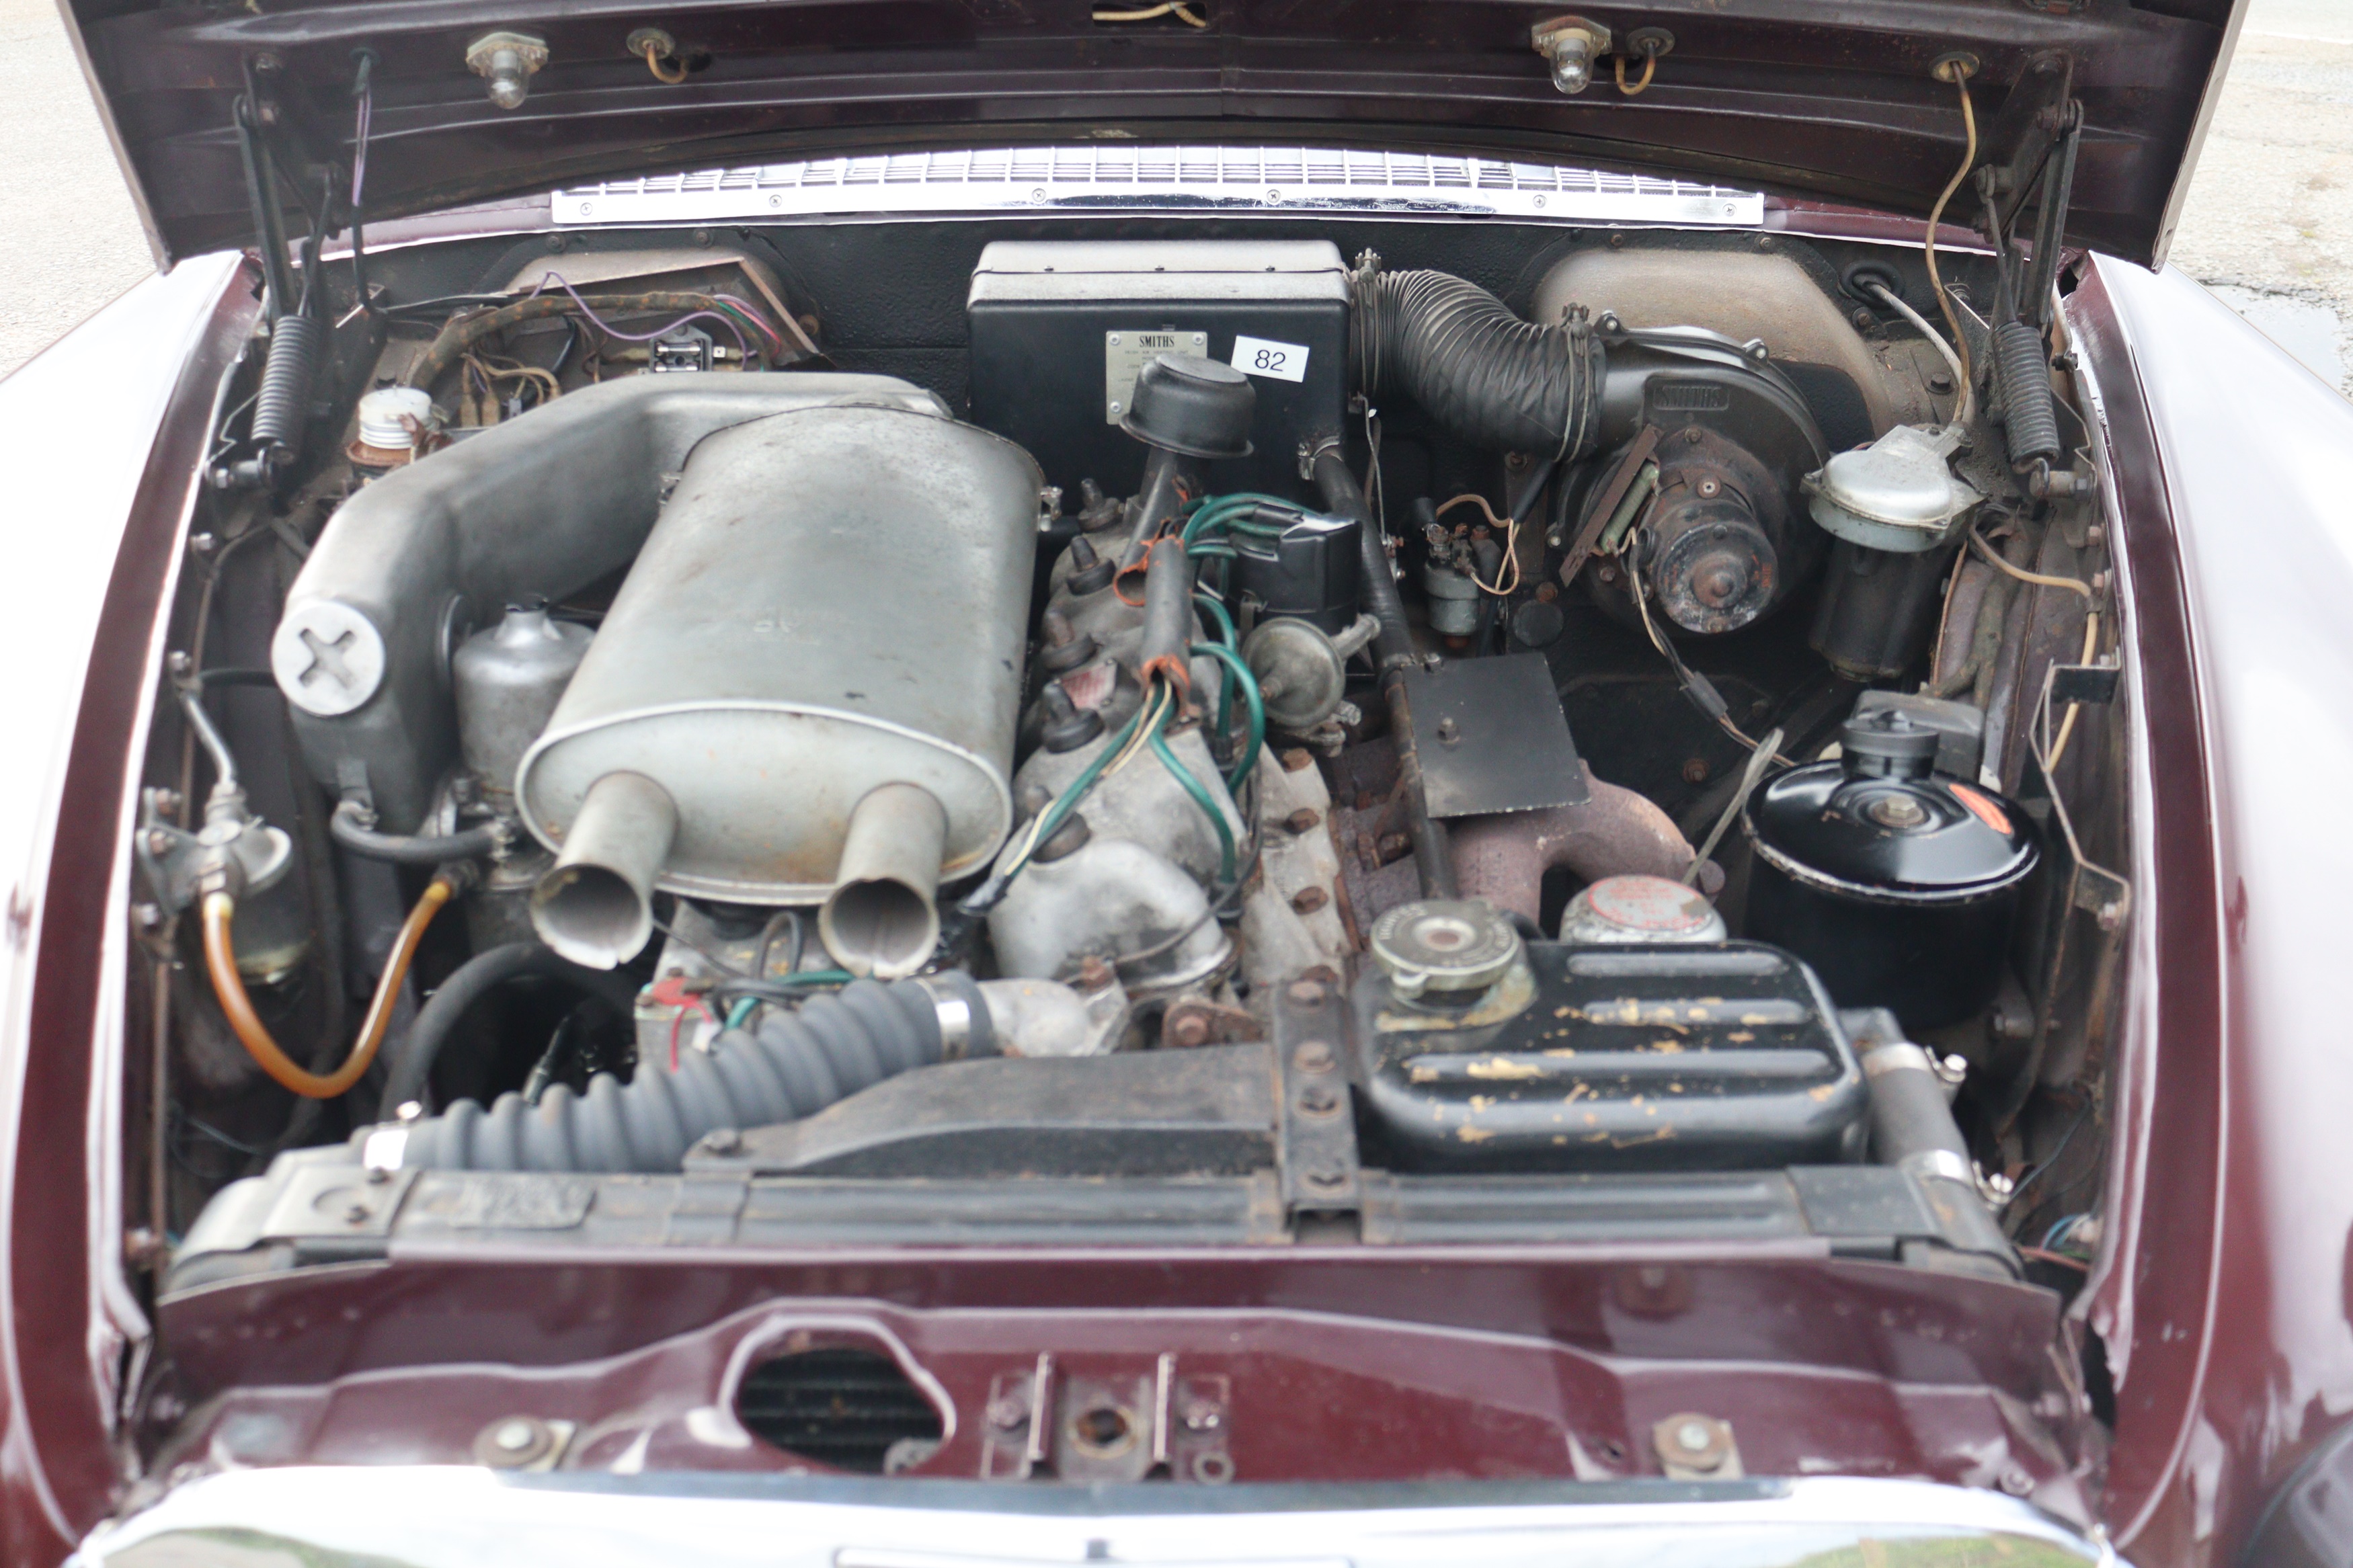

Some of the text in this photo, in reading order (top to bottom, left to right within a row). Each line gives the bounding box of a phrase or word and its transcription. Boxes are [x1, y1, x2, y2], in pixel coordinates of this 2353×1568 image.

[1139, 335, 1175, 347] SMITHS
[1255, 349, 1286, 372] 82
[1661, 386, 1722, 407] SMITHS
